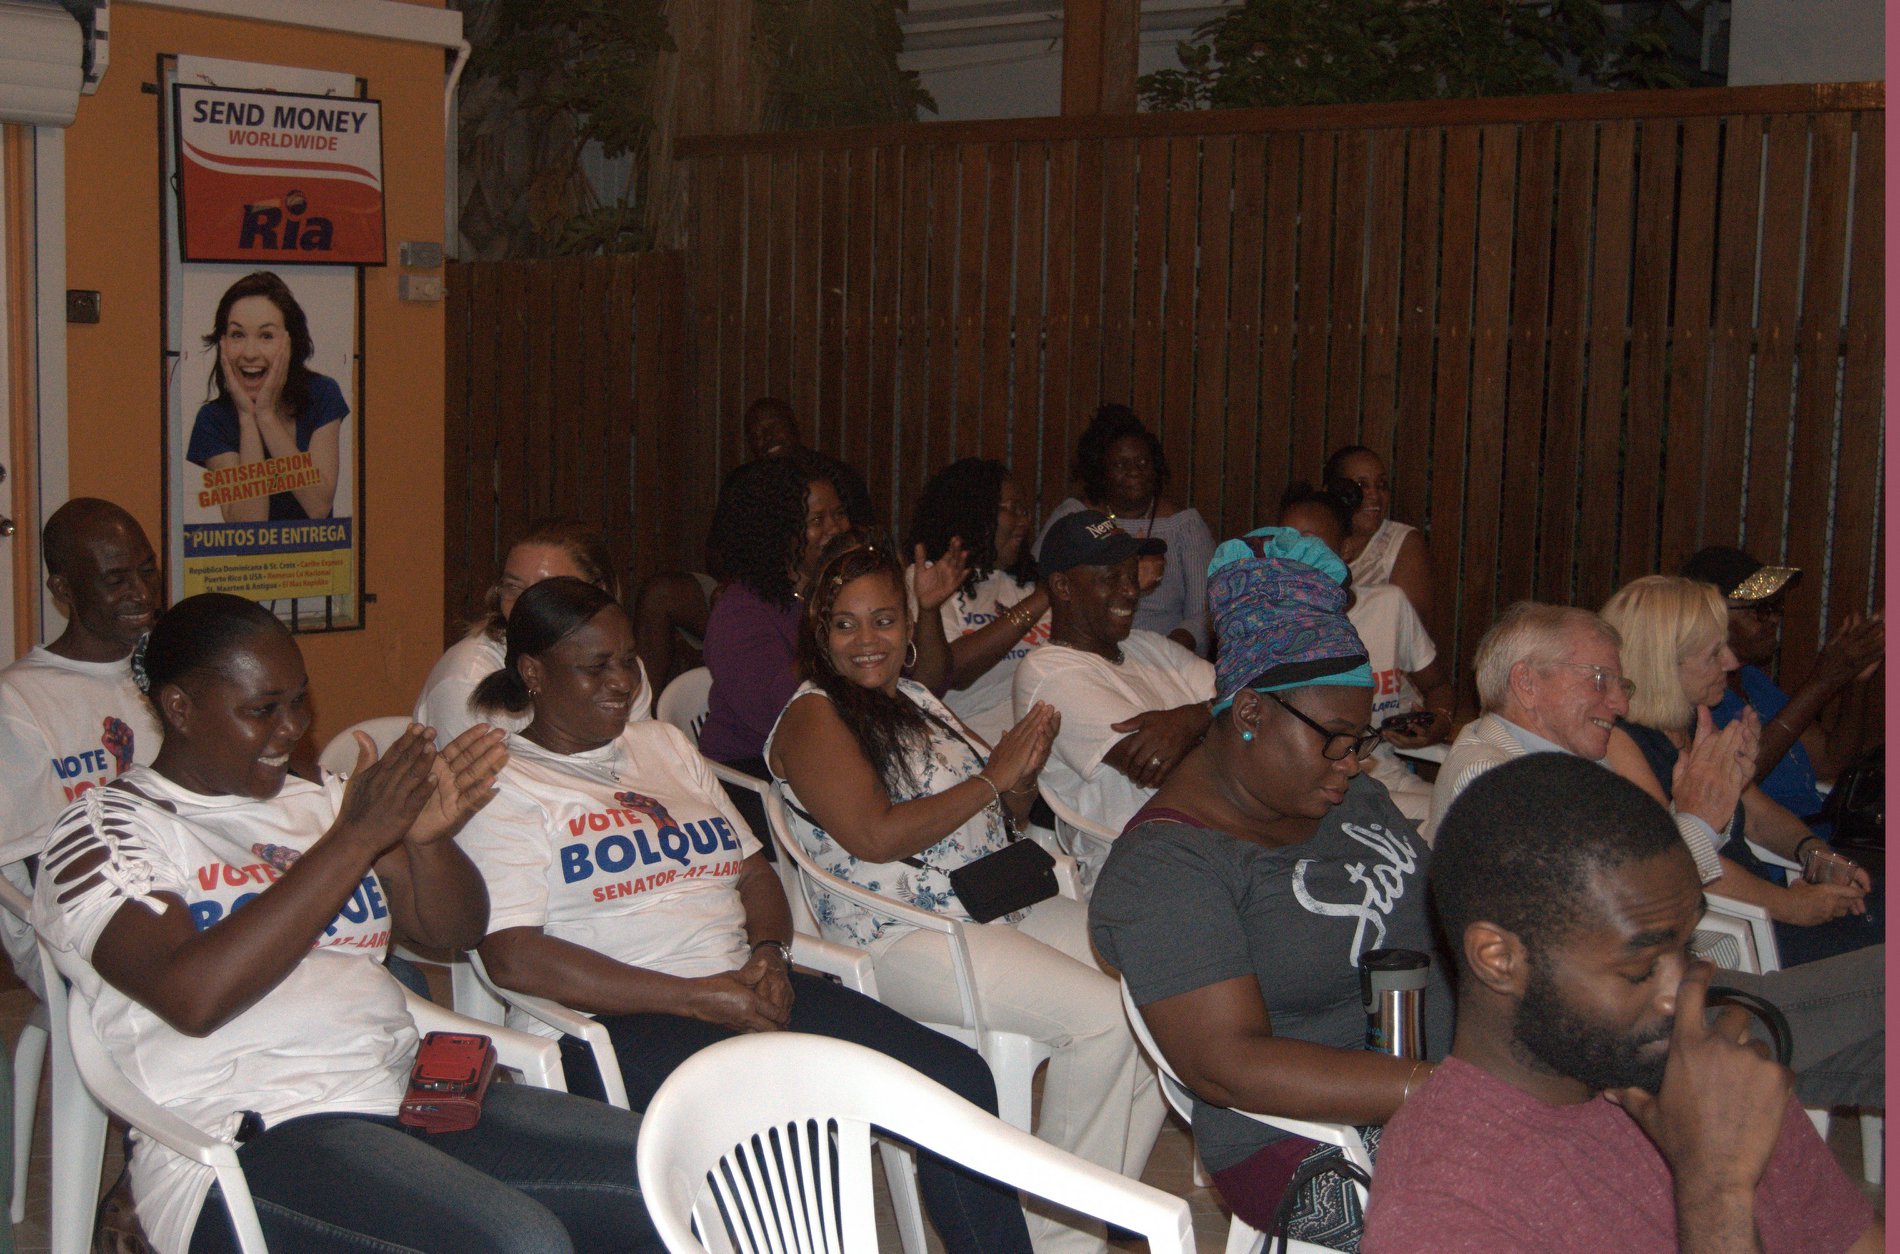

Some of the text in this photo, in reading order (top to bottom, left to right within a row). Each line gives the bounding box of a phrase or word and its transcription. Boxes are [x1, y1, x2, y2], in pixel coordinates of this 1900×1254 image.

[193, 100, 367, 134] SEND MONEY
[229, 130, 338, 151] WORLDWIDE
[239, 189, 334, 250] Ria
[203, 453, 313, 488] SATISFACCION
[198, 469, 321, 508] GARANTIZADA!!!
[193, 525, 346, 548] PUNTOS DE ENTREGA
[52, 748, 108, 779] VOTE
[569, 809, 642, 837] VOTE
[560, 817, 743, 884] BOLQUE
[198, 863, 277, 891] VOTE
